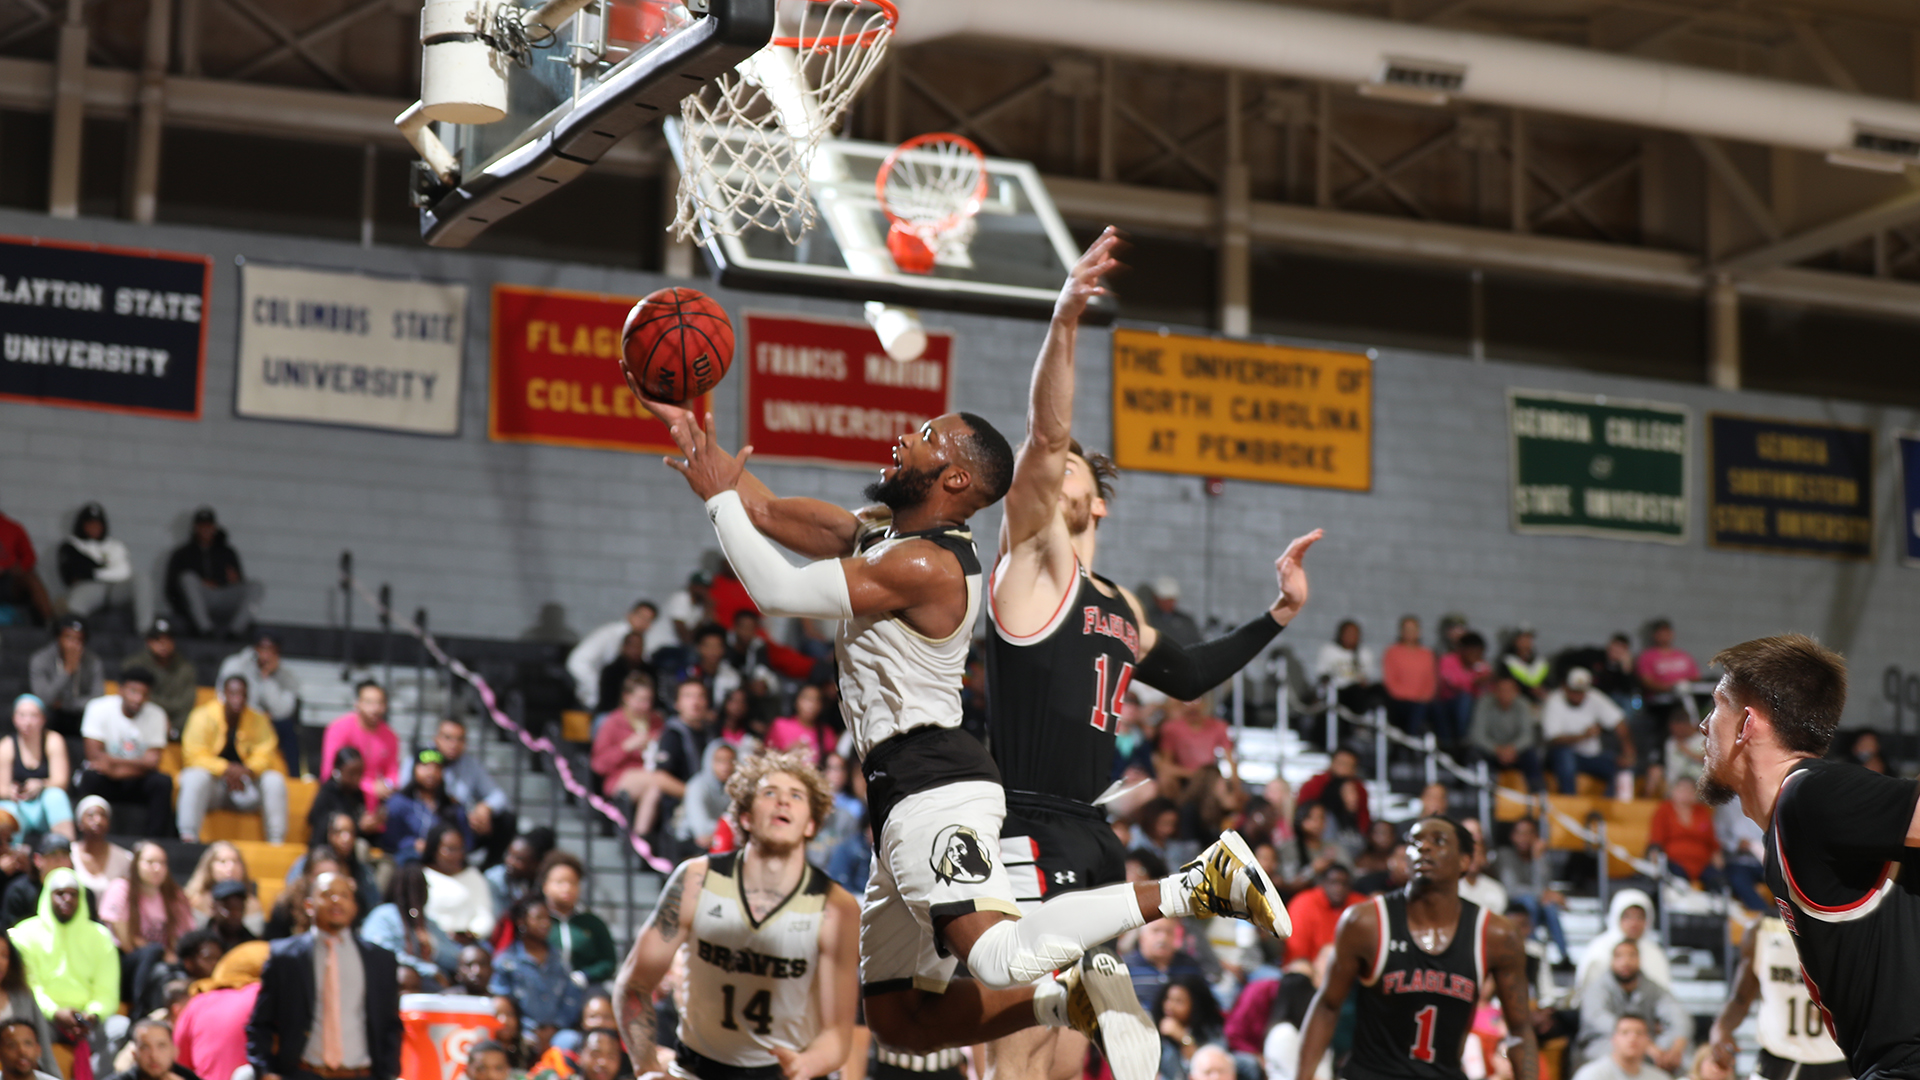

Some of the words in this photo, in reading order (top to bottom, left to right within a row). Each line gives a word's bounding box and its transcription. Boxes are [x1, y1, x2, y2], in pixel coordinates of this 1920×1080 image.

[115, 286, 202, 323] STATE
[254, 297, 370, 337] COLUMBUS
[391, 310, 457, 346] STATE
[3, 332, 171, 378] UNIVERSITY
[756, 341, 848, 381] FRANCIS
[1118, 345, 1164, 376] THE
[1180, 352, 1322, 391] UNIVERSITY
[1336, 368, 1365, 395] OF
[262, 355, 439, 402] UNIVERSITY
[1123, 387, 1212, 419] NORTH
[1230, 395, 1361, 432] CAROLINA
[1149, 430, 1177, 456] AT
[1198, 432, 1337, 473] PEMBROKE
[1584, 487, 1685, 526] UNIVERSITY
[1090, 653, 1134, 737] 14
[698, 938, 808, 979] BRAVES
[721, 985, 774, 1035] 14
[1788, 997, 1823, 1037] 10
[1409, 1004, 1438, 1064] 1
